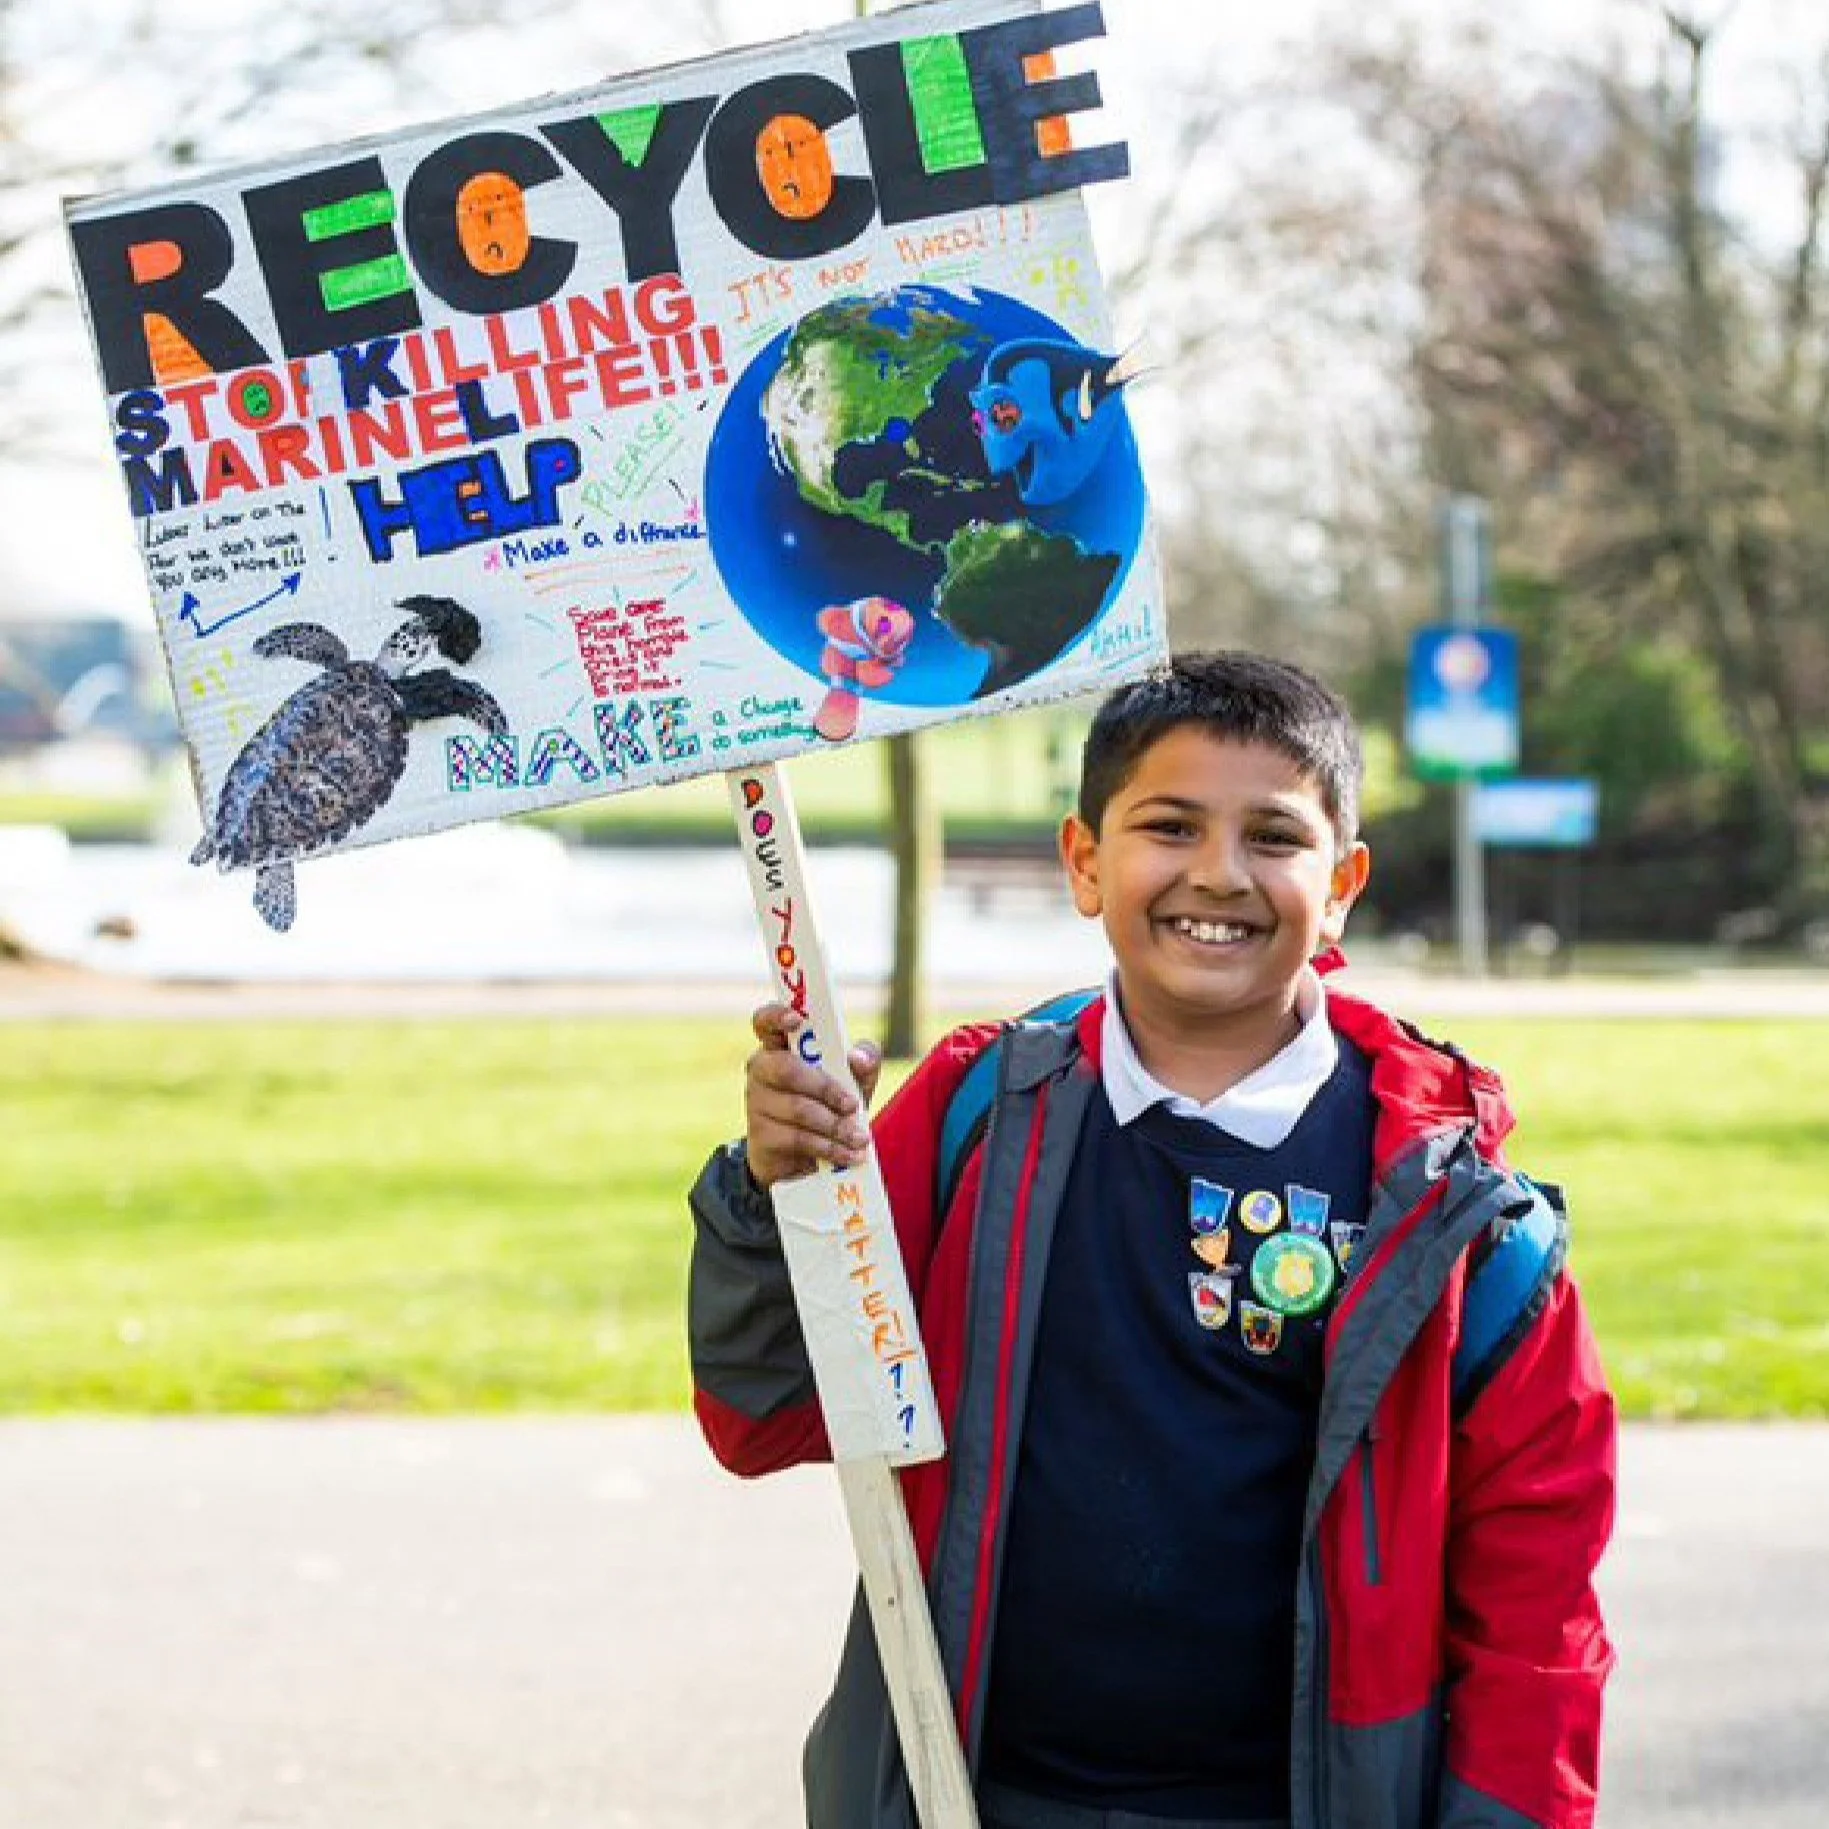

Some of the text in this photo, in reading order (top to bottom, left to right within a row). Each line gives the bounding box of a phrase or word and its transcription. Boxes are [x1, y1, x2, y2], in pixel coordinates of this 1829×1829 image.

[68, 1, 1131, 395] RECYCLE
[333, 273, 697, 409] KILLING
[347, 438, 581, 563] HELP
[583, 531, 603, 549] a
[446, 696, 701, 792] MAKE
